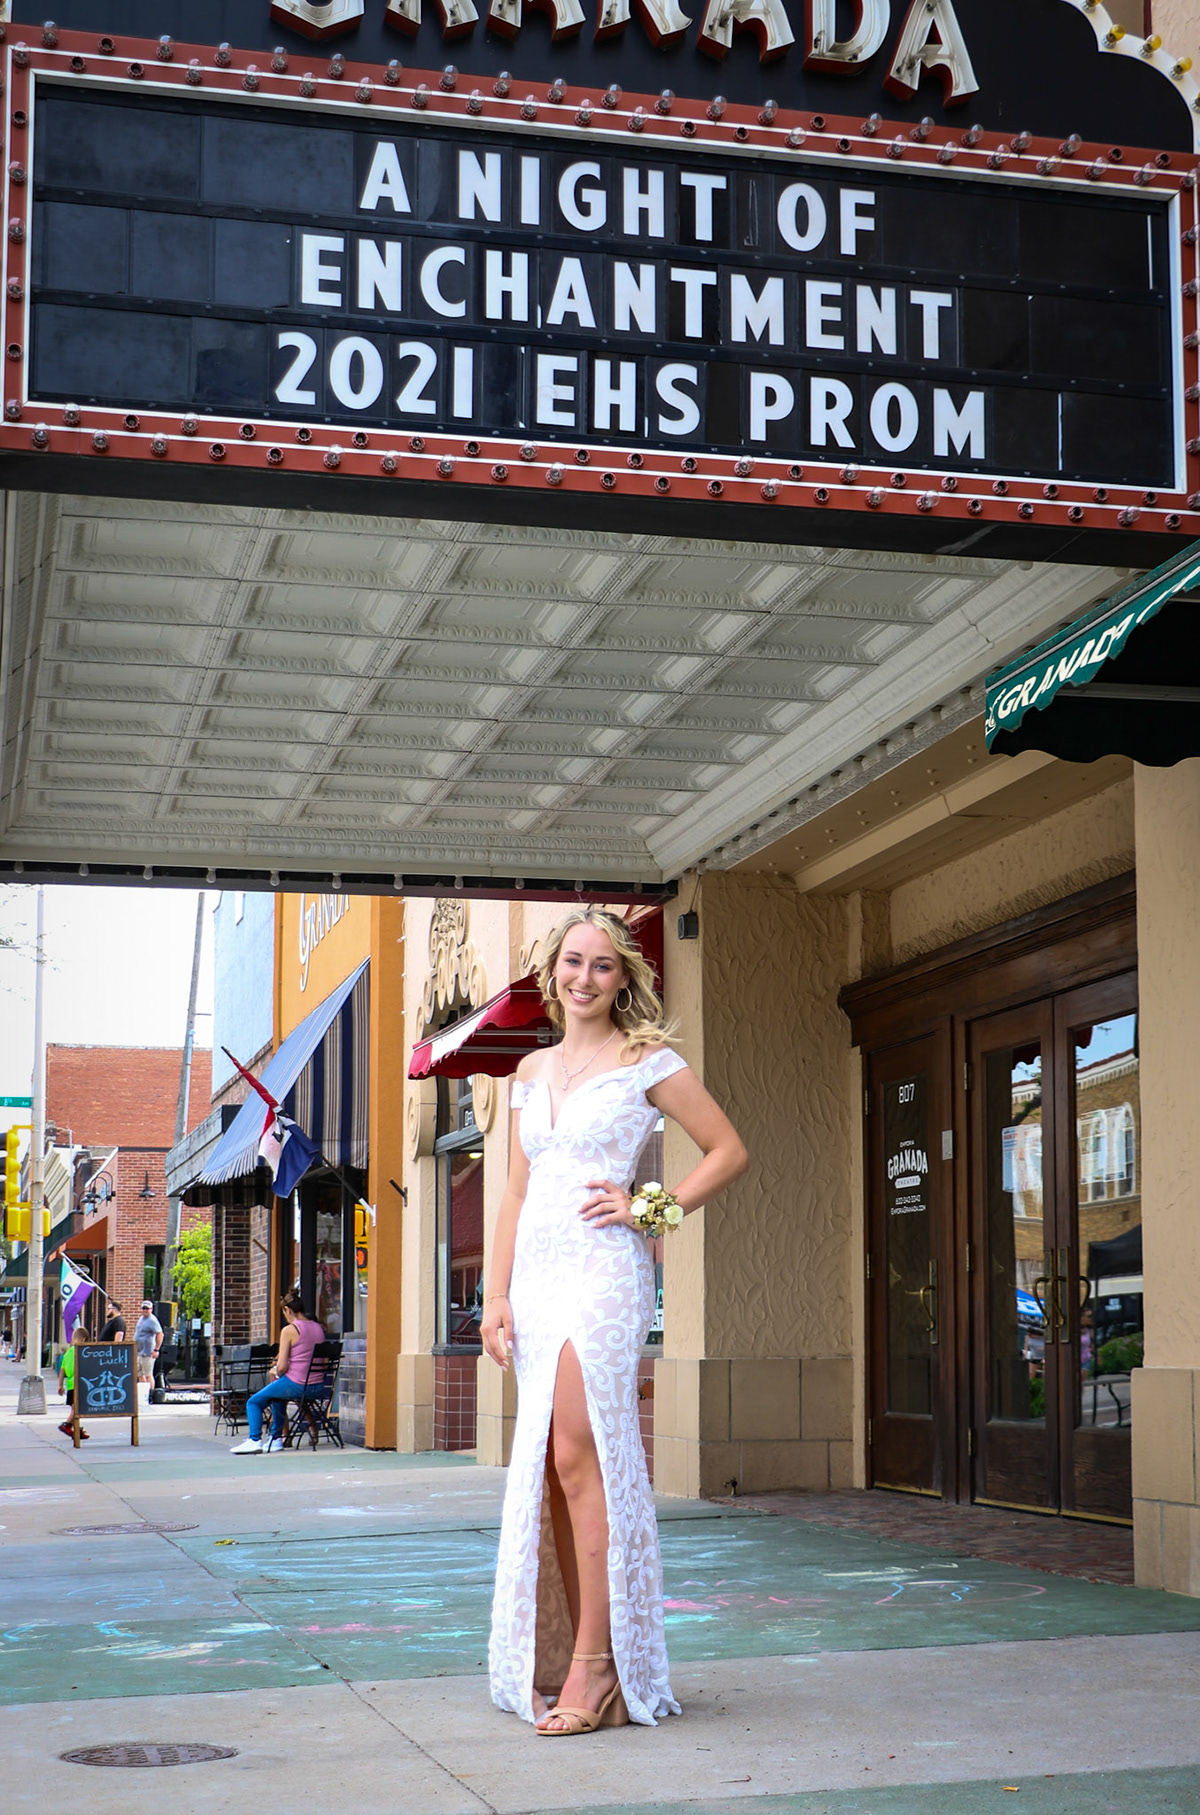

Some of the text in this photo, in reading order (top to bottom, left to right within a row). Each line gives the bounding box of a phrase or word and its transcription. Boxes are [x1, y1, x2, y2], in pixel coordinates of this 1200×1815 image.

[360, 141, 875, 256] A NIGHT OF
[301, 234, 952, 359] ENCHANTMENT
[275, 331, 985, 459] 2021 EHS PROM
[998, 612, 1135, 720] GRANADA
[898, 1083, 915, 1103] 807
[888, 1149, 928, 1180] GRANADA
[81, 1345, 113, 1358] Good
